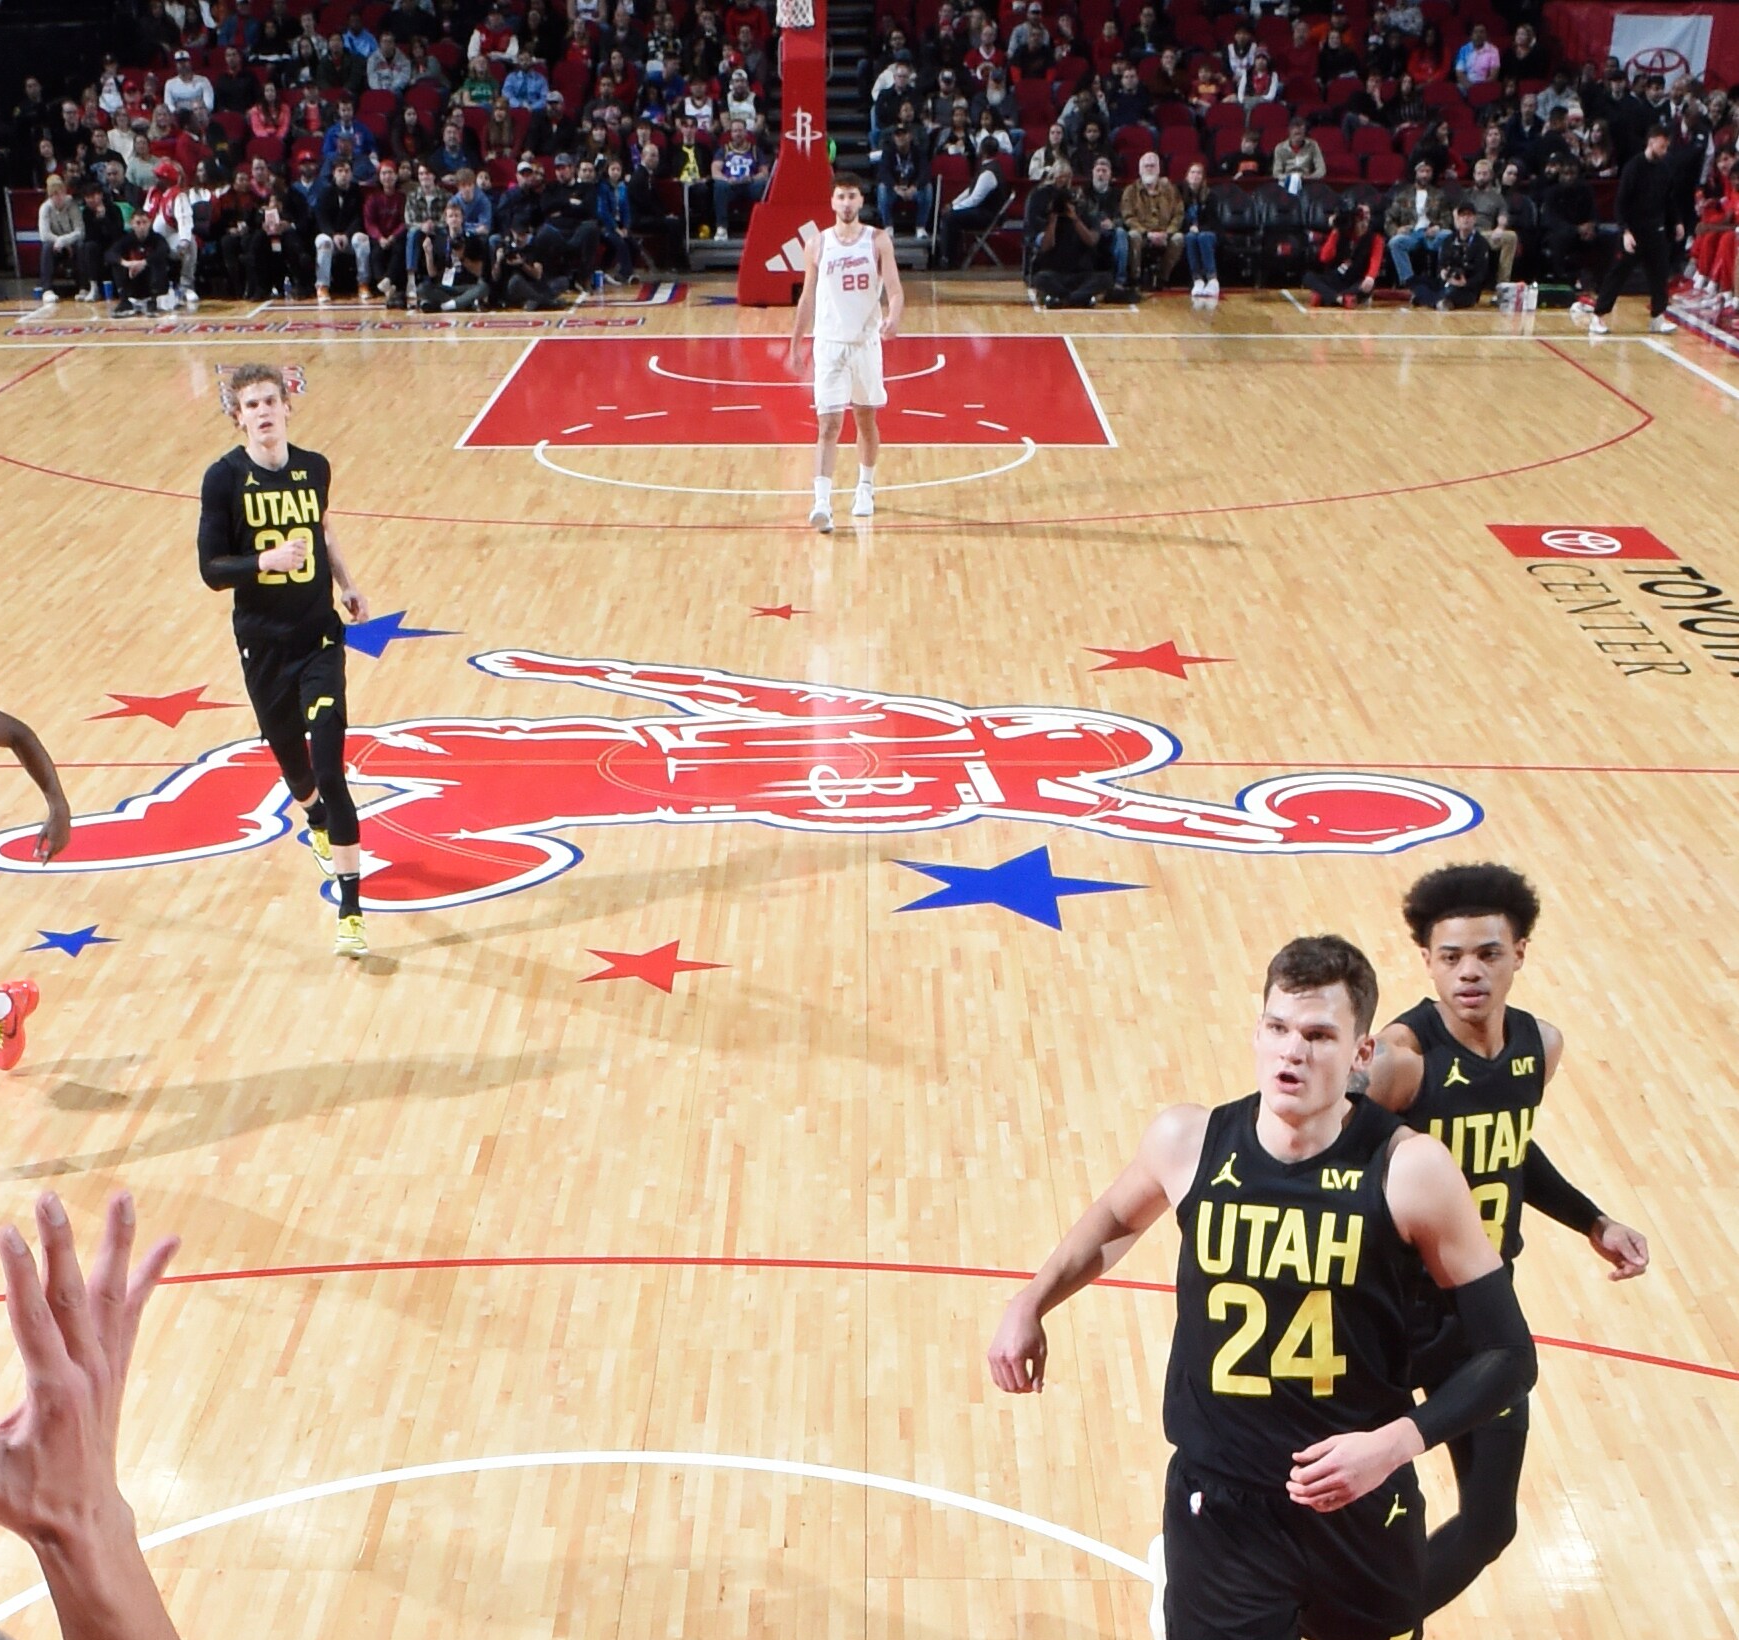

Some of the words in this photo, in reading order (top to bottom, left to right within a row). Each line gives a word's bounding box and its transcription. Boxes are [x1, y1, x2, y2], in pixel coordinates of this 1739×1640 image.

[827, 256, 869, 275] H-Town
[842, 274, 869, 291] 28
[244, 489, 320, 527] UTAH
[1526, 563, 1692, 676] CENTER
[1622, 565, 1739, 678] TOYO
[1512, 1056, 1536, 1076] LVT
[1429, 1105, 1541, 1174] UTAH
[1321, 1168, 1364, 1191] LVT
[1197, 1201, 1364, 1285] UTAH
[1208, 1282, 1347, 1396] 24
